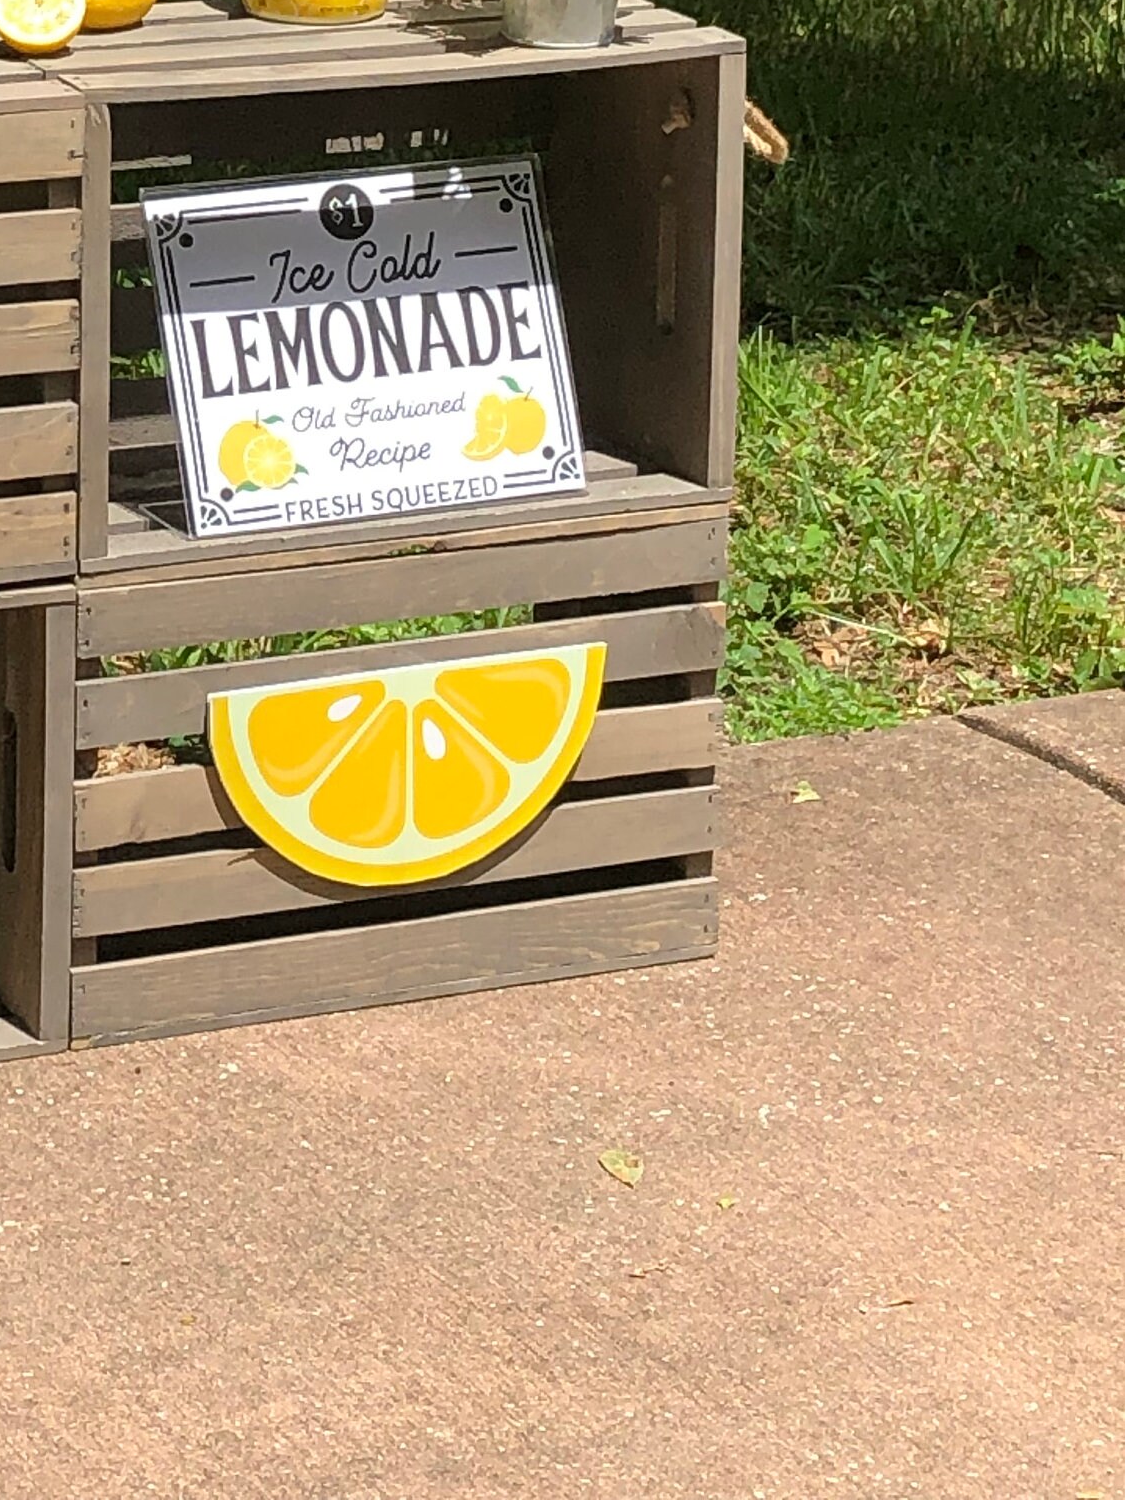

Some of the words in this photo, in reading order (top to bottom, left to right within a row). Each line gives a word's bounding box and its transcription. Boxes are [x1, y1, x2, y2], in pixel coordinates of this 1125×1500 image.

[328, 193, 364, 227] $1
[269, 249, 334, 304] Ice
[347, 231, 441, 293] Cold
[191, 281, 541, 399] LEMONADE
[291, 406, 336, 432] Old
[345, 391, 466, 427] Fashioned
[329, 437, 431, 473] Recipe
[285, 493, 363, 522] FRESH
[371, 476, 498, 512] SQUEEZED
